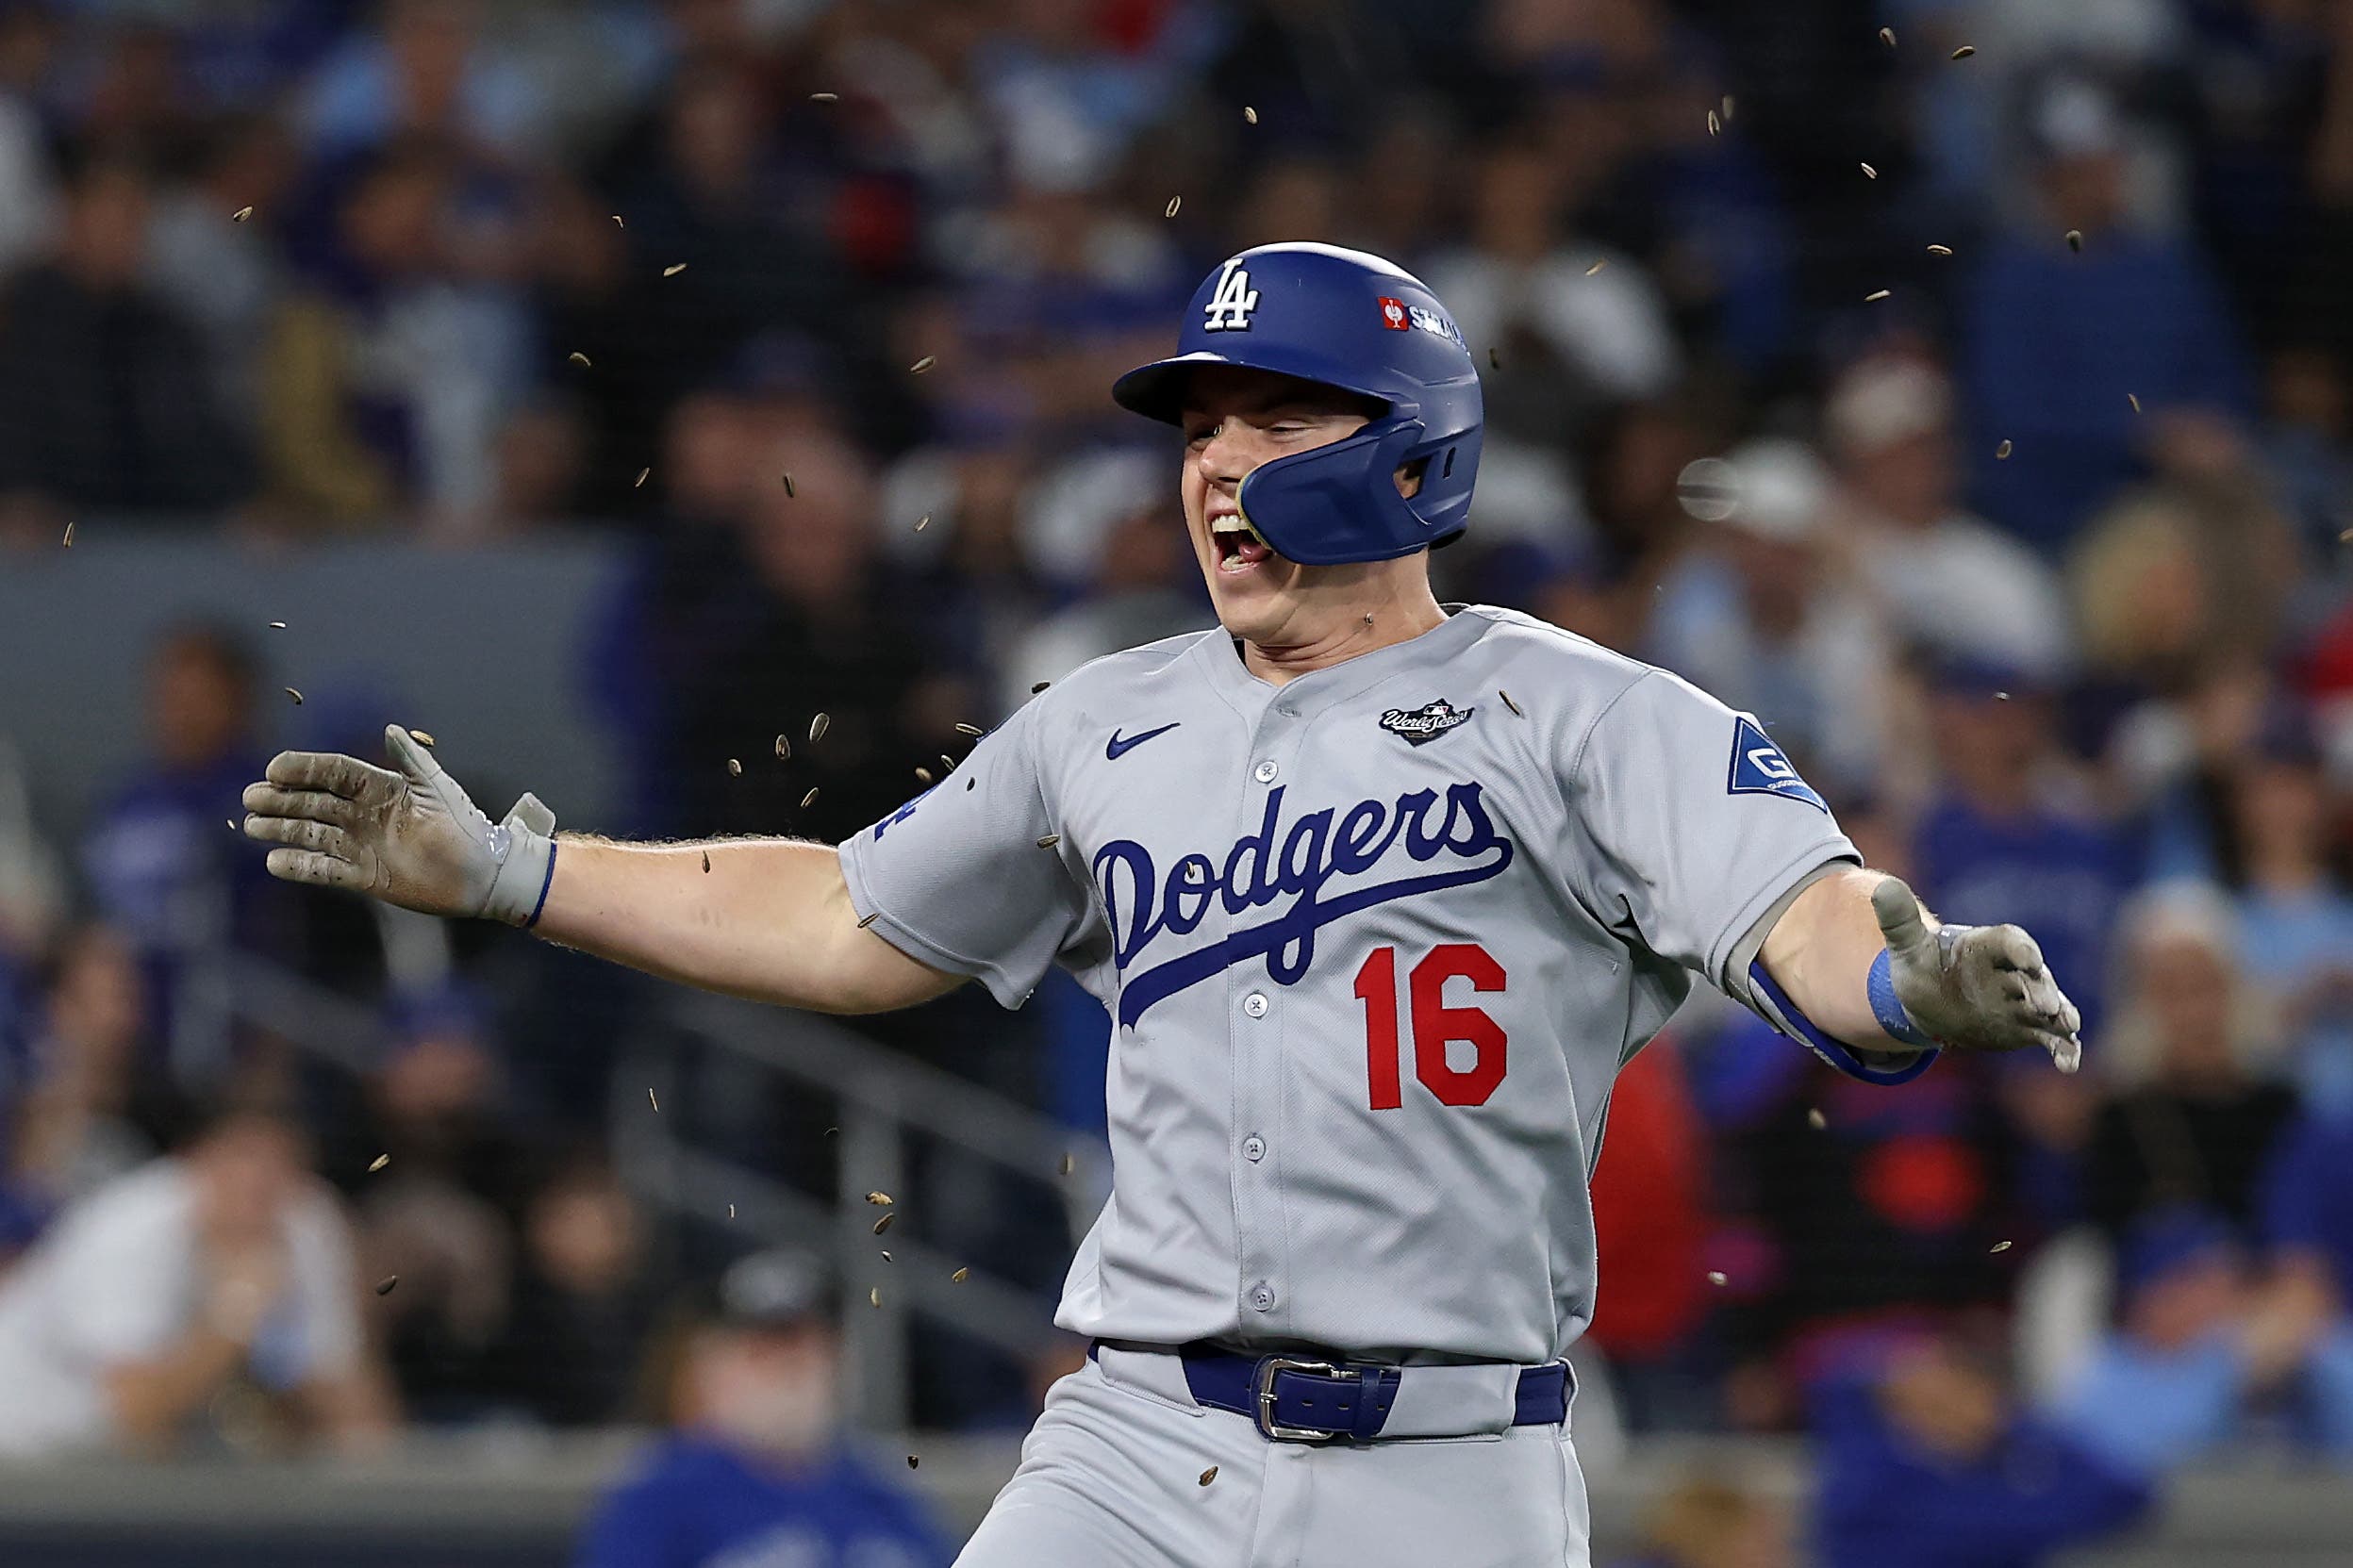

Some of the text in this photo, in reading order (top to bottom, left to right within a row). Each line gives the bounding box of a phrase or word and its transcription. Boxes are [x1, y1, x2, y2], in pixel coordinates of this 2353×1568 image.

[1204, 257, 1258, 330] LA
[1383, 710, 1433, 728] World
[1747, 748, 1796, 778] G
[1093, 781, 1514, 987] Dodgers
[1353, 944, 1507, 1110] 16
